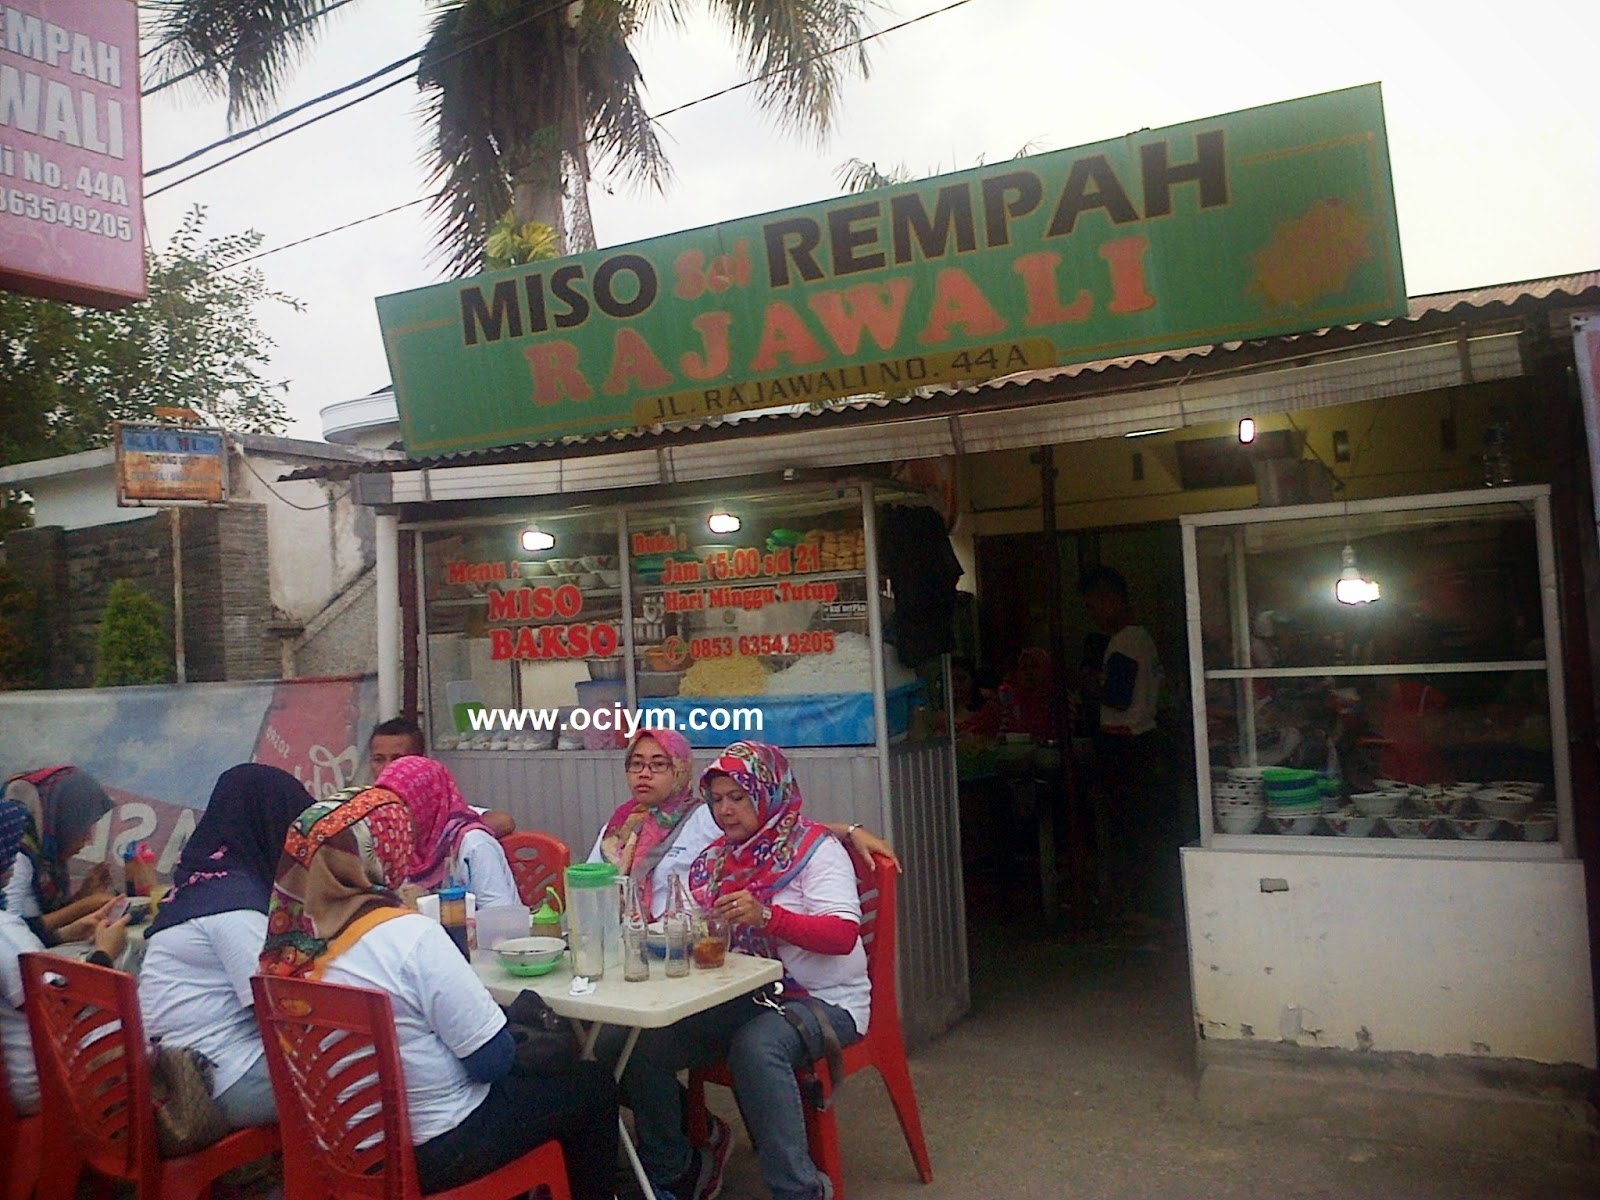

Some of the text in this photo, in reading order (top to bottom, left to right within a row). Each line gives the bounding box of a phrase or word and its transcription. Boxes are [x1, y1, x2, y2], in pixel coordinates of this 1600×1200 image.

[0, 6, 121, 88] MPAH
[23, 150, 70, 192] No.
[76, 165, 129, 207] 44A
[459, 254, 658, 347] MISO
[762, 129, 1229, 288] REMPAH
[523, 238, 1155, 406] RAJAWALI
[705, 366, 868, 411] RAJAWALI
[880, 357, 939, 386] NO.
[447, 560, 506, 584] Menu
[662, 558, 700, 584] Jam
[488, 584, 583, 621] MISO
[664, 581, 838, 613] Hari Minggu Tutup
[490, 623, 618, 660] BAKSO
[690, 629, 835, 660] 0853 6354 9205
